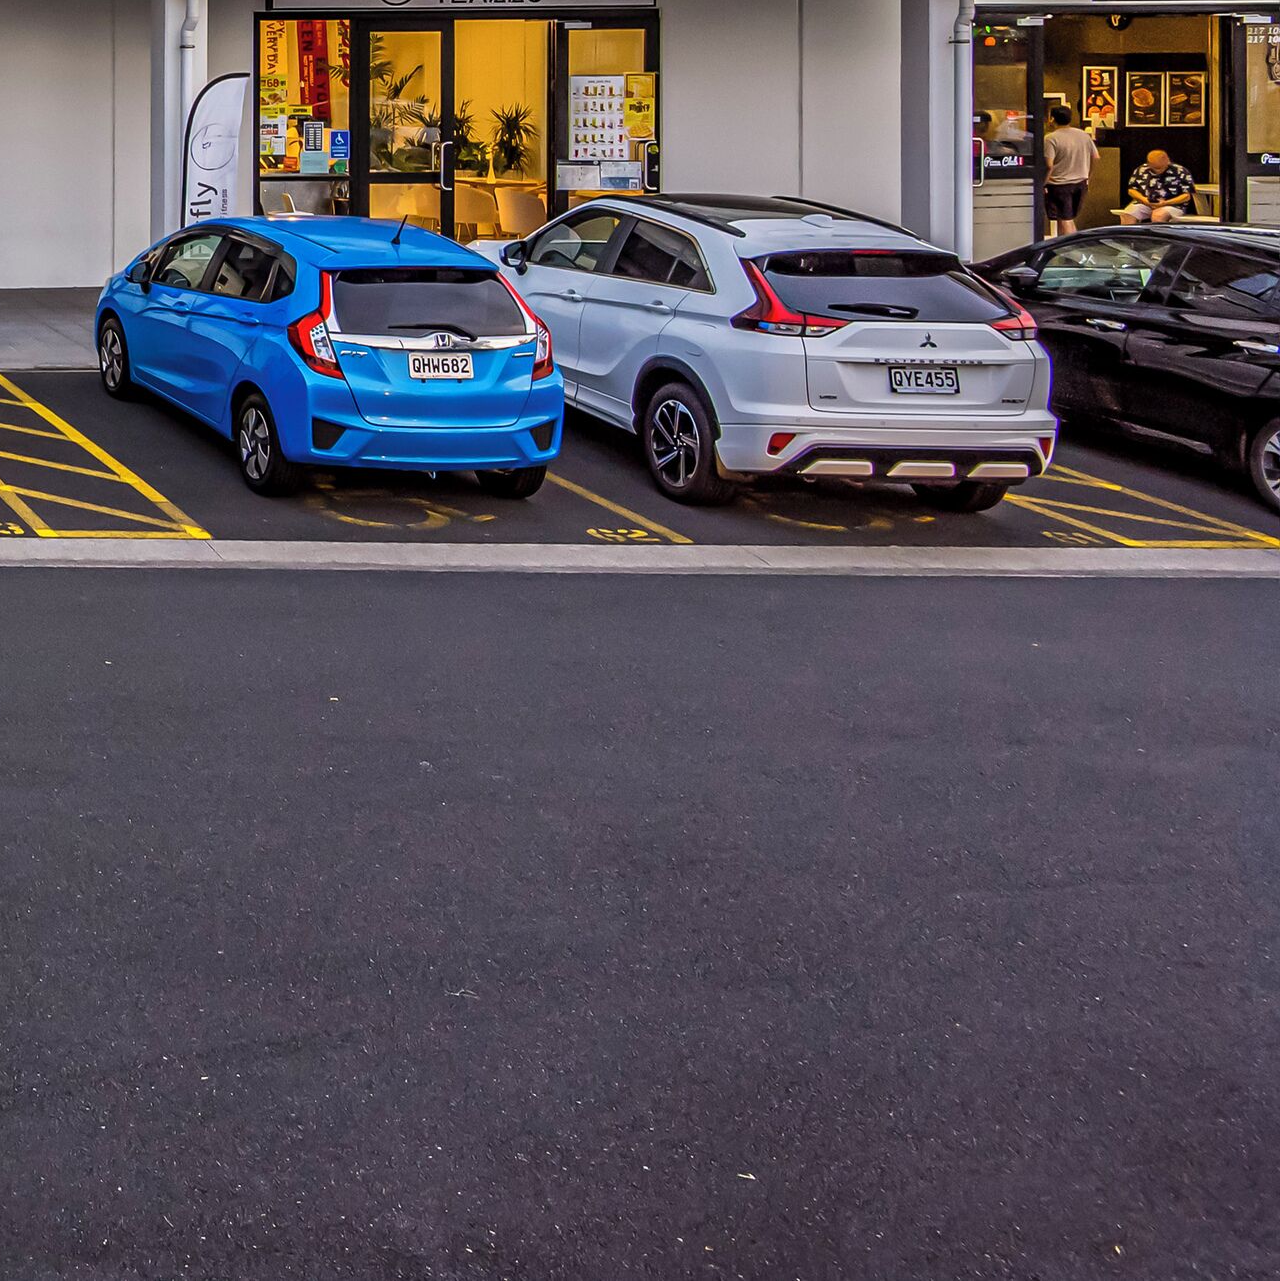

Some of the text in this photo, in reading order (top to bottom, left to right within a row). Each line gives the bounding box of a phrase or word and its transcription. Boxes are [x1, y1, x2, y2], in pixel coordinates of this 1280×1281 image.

[189, 181, 219, 224] fly
[220, 188, 228, 217] itness
[412, 357, 471, 374] QHW682
[942, 358, 984, 366] CROSS
[893, 371, 956, 388] QYE455
[585, 528, 662, 543] 62
